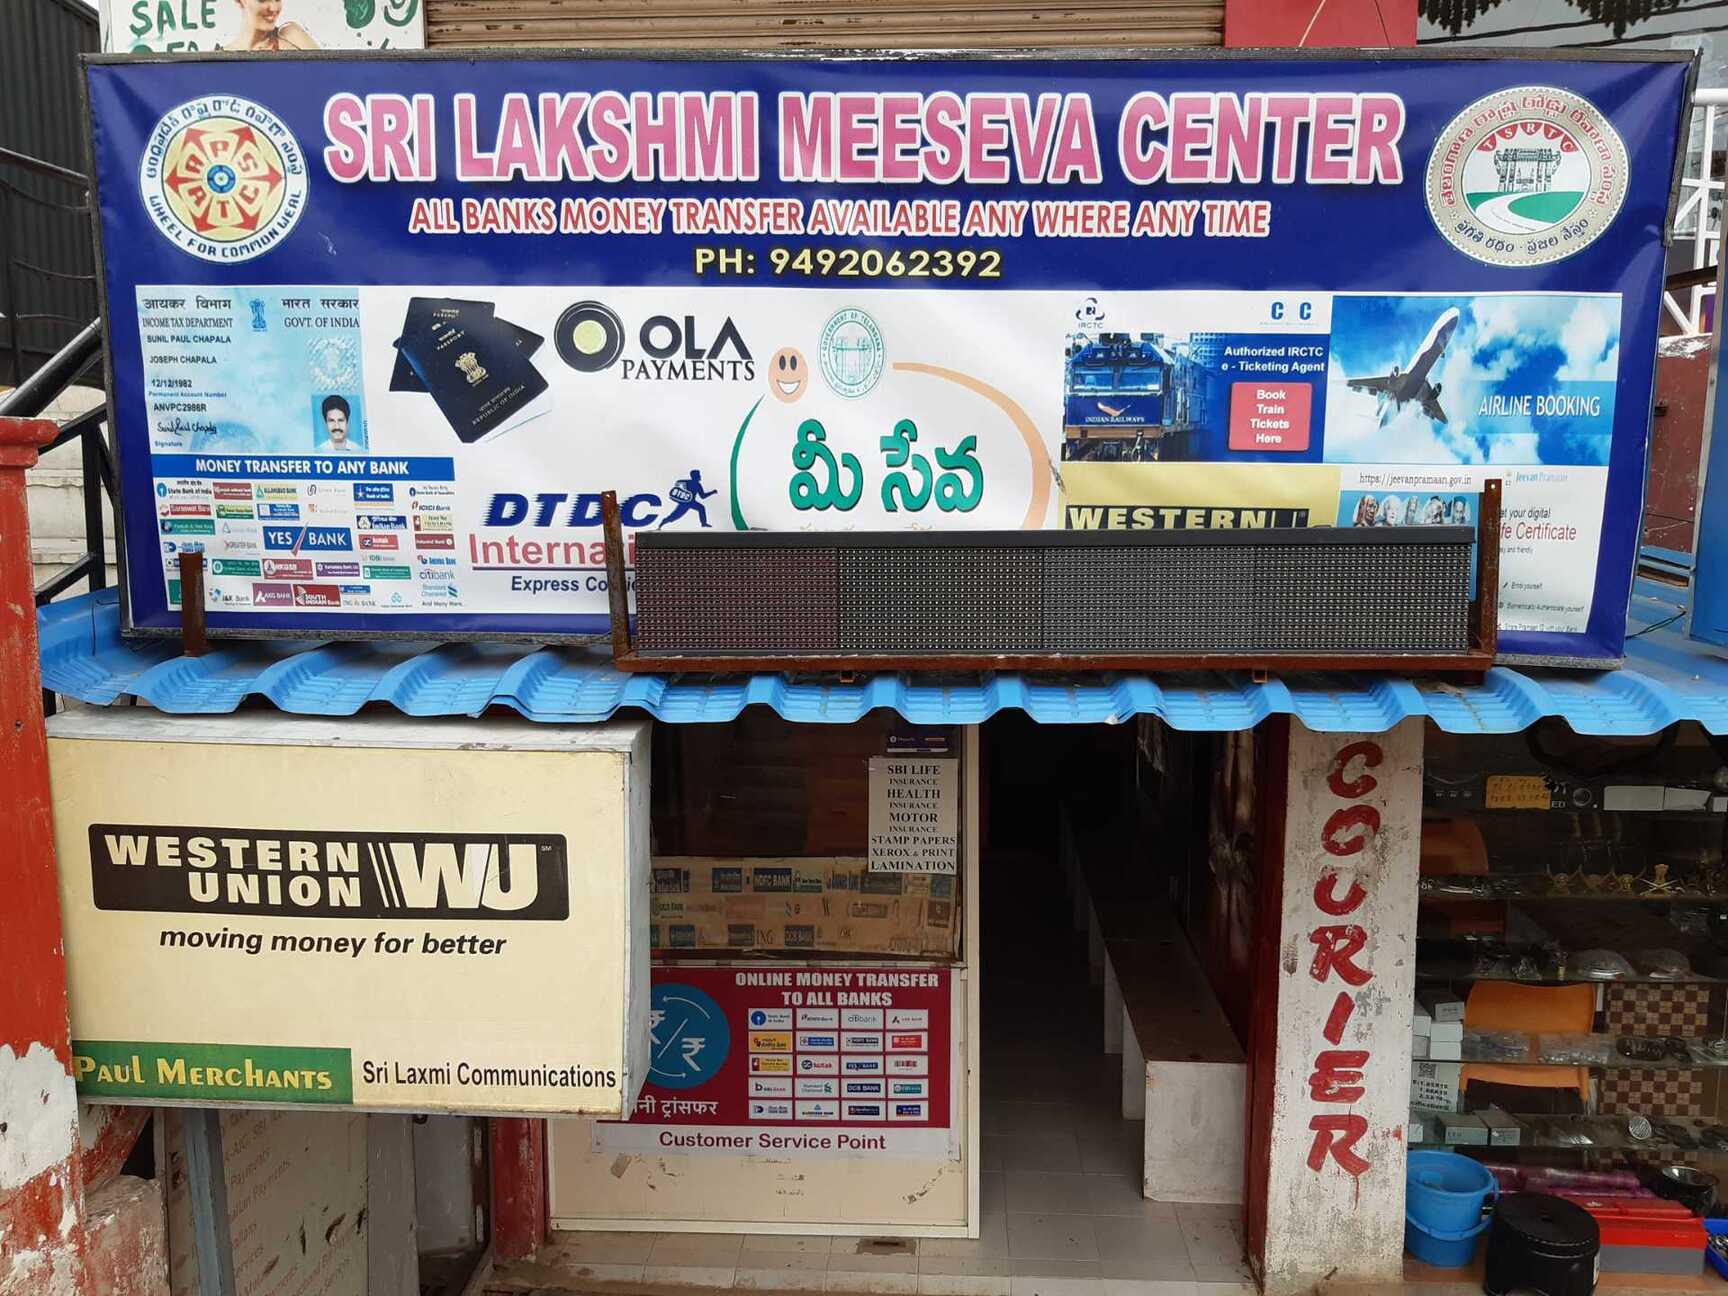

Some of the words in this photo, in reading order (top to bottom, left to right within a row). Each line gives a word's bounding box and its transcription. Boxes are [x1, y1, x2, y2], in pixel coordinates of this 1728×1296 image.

[129, 0, 216, 37] SALE
[324, 93, 436, 182] SRI
[454, 91, 759, 182] LAKSHMI
[778, 91, 1103, 184] MEESEVA
[1119, 91, 1406, 184] CENTER
[1484, 122, 1576, 152] TSRTC
[149, 195, 184, 241] WHEEL
[187, 237, 217, 257] FOR
[221, 229, 280, 258] COMMON
[280, 189, 302, 229] WEAL
[408, 198, 460, 235] ALL
[463, 198, 556, 235] BANKS
[560, 198, 667, 235] MONEY
[671, 198, 806, 236] TRANSFER
[807, 199, 960, 236] AVAILABLE
[962, 200, 1029, 237] ANY
[1033, 200, 1131, 237] WHERE
[1134, 200, 1200, 237] ANY
[1202, 200, 1271, 237] TIME
[695, 248, 756, 275] PH:
[769, 249, 1001, 277] 9492062392
[144, 298, 185, 310] आयकर
[195, 295, 231, 310] विभाग
[282, 299, 311, 310] भारत
[320, 299, 360, 310] सरकार
[142, 317, 170, 328] INCOME
[170, 317, 186, 328] TAX
[187, 317, 233, 328] DEPARTMENT
[284, 317, 313, 328] GOVT.
[315, 317, 329, 328] OF
[330, 317, 360, 328] INDIA
[147, 334, 168, 344] SUNIL
[170, 334, 191, 344] PAUL
[192, 334, 232, 344] CHAPALA
[640, 315, 752, 360] OLA
[149, 355, 179, 364] JOSEPH
[180, 355, 217, 364] CHAPALA
[1224, 345, 1285, 358] Authorized
[1287, 346, 1325, 358] IRCTC
[621, 358, 755, 382] PAYMENTS
[1238, 361, 1289, 374] Ticketing
[1291, 362, 1325, 375] Agent
[1256, 389, 1286, 400] Book
[1256, 404, 1285, 415] Train
[1478, 396, 1532, 417] AIRLINE
[1536, 396, 1601, 417] BOOKING
[1085, 416, 1111, 424] INDIAN
[1111, 416, 1145, 424] RAILWAYS
[1250, 418, 1290, 430] Tickets
[1255, 433, 1282, 444] Here
[196, 459, 242, 473] MONEY
[244, 459, 311, 474] TRANSFER
[316, 461, 334, 474] TO
[337, 461, 367, 475] ANY
[370, 461, 409, 476] BANK
[789, 418, 864, 512] మీ
[879, 418, 985, 513] సేవ
[1359, 471, 1472, 487] https://jeevanpramaan.gov.in
[484, 493, 663, 528] DTDC
[1068, 507, 1266, 529] WESTERN
[1509, 508, 1527, 520] your
[1527, 508, 1551, 521] digital
[268, 531, 293, 545] YES
[308, 533, 347, 546] BANK
[1515, 521, 1577, 541] Certificate
[511, 576, 579, 593] Express
[887, 765, 909, 775] SBI
[911, 765, 941, 775] LIFE
[887, 789, 941, 799] HEALTH
[889, 812, 938, 823] MOTOR
[871, 836, 910, 845] STAMP
[913, 836, 956, 845] PAPERS
[104, 833, 360, 873] WESTERN
[871, 848, 910, 857] XEROX
[922, 848, 954, 857] PRINT
[871, 860, 956, 871] LAMINATION
[388, 841, 539, 910] WU
[187, 871, 362, 908] UNION
[159, 926, 263, 955] moving
[271, 932, 366, 958] money
[373, 930, 414, 955] for
[420, 930, 507, 956] better
[1306, 740, 1385, 1178] COURIER
[735, 972, 793, 987] ONLINE
[796, 972, 851, 988] MONEY
[856, 973, 939, 988] TRANSFER
[782, 991, 804, 1006] TO
[807, 991, 834, 1006] ALL
[837, 991, 893, 1006] BANKS
[363, 1060, 391, 1086] Sri
[395, 1062, 453, 1087] Laxmi
[457, 1063, 617, 1091] Communications
[660, 1096, 719, 1118] ट्रांसफर
[659, 1131, 751, 1149] Customer
[754, 1132, 831, 1150] Service
[836, 1133, 887, 1150] Point
